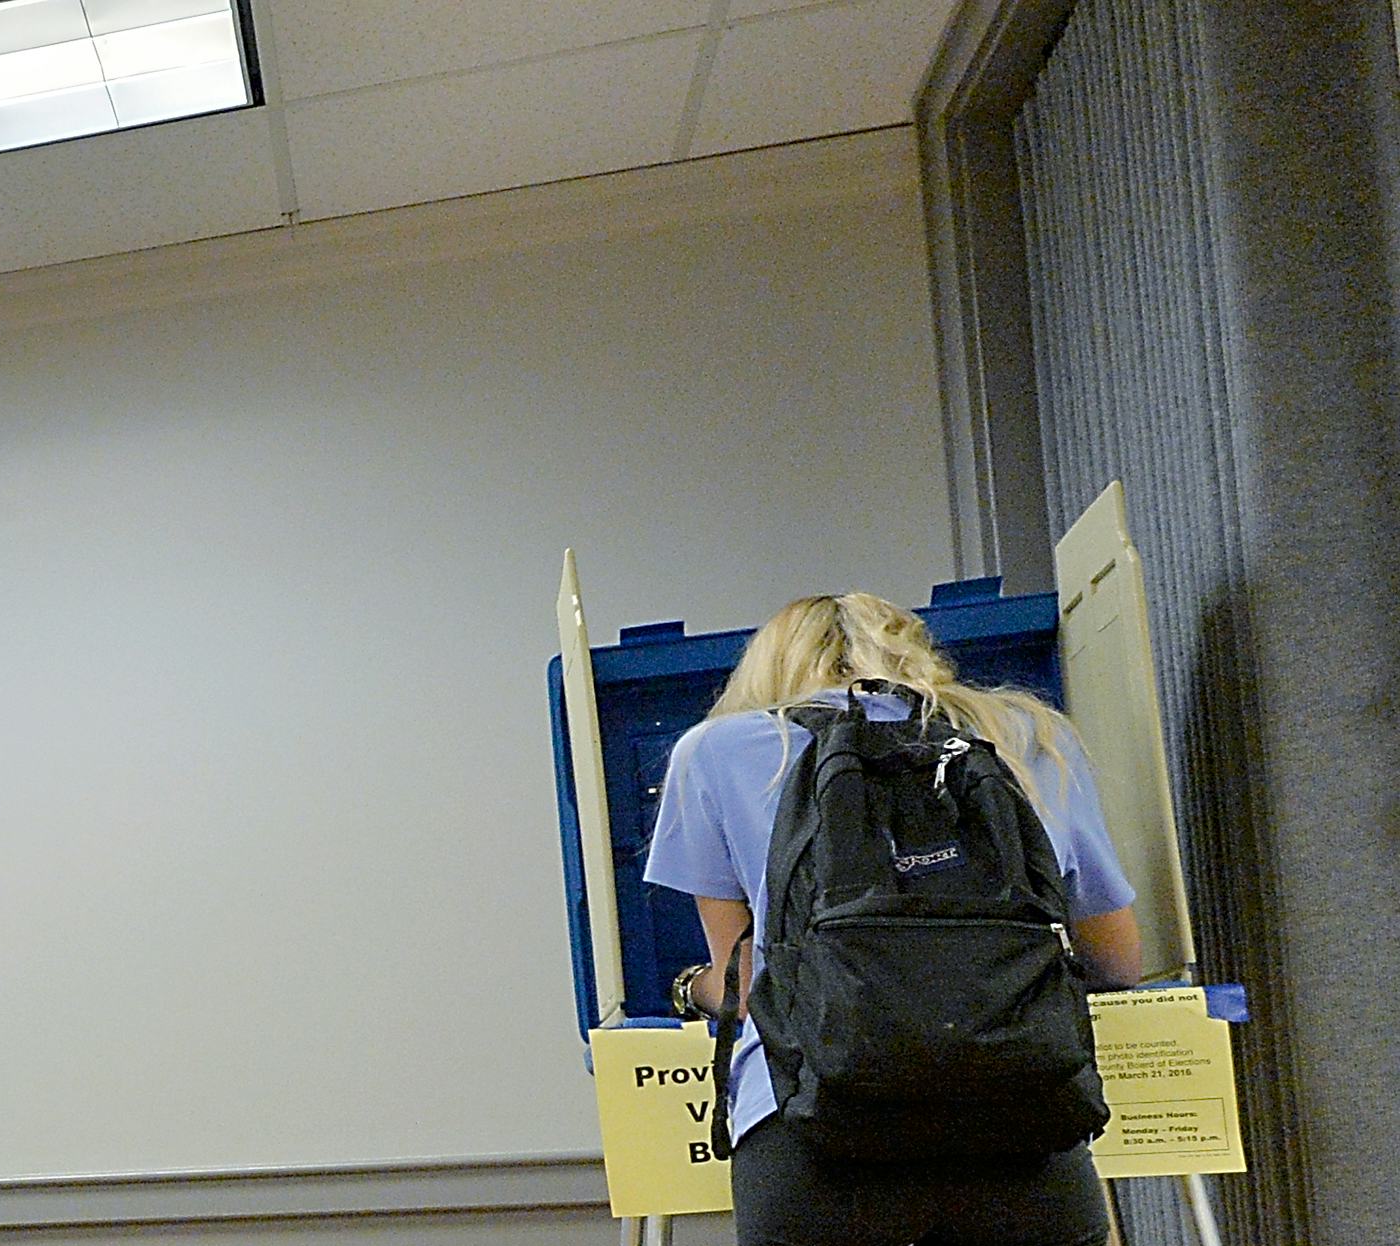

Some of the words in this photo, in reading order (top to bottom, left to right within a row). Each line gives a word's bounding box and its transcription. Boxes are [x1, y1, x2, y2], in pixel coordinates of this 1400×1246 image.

[1089, 998, 1128, 1008] cause
[1131, 997, 1152, 1006] you
[1156, 995, 1174, 1003] did
[1099, 1062, 1124, 1072] ounty
[1127, 1060, 1154, 1070] Board
[1157, 1060, 1166, 1068] of
[1168, 1057, 1212, 1067] Elections
[634, 1062, 714, 1087] Prov
[1118, 1070, 1149, 1080] March
[1120, 1112, 1164, 1121] Business
[1122, 1127, 1159, 1136] Monday
[1169, 1125, 1199, 1134] Friday
